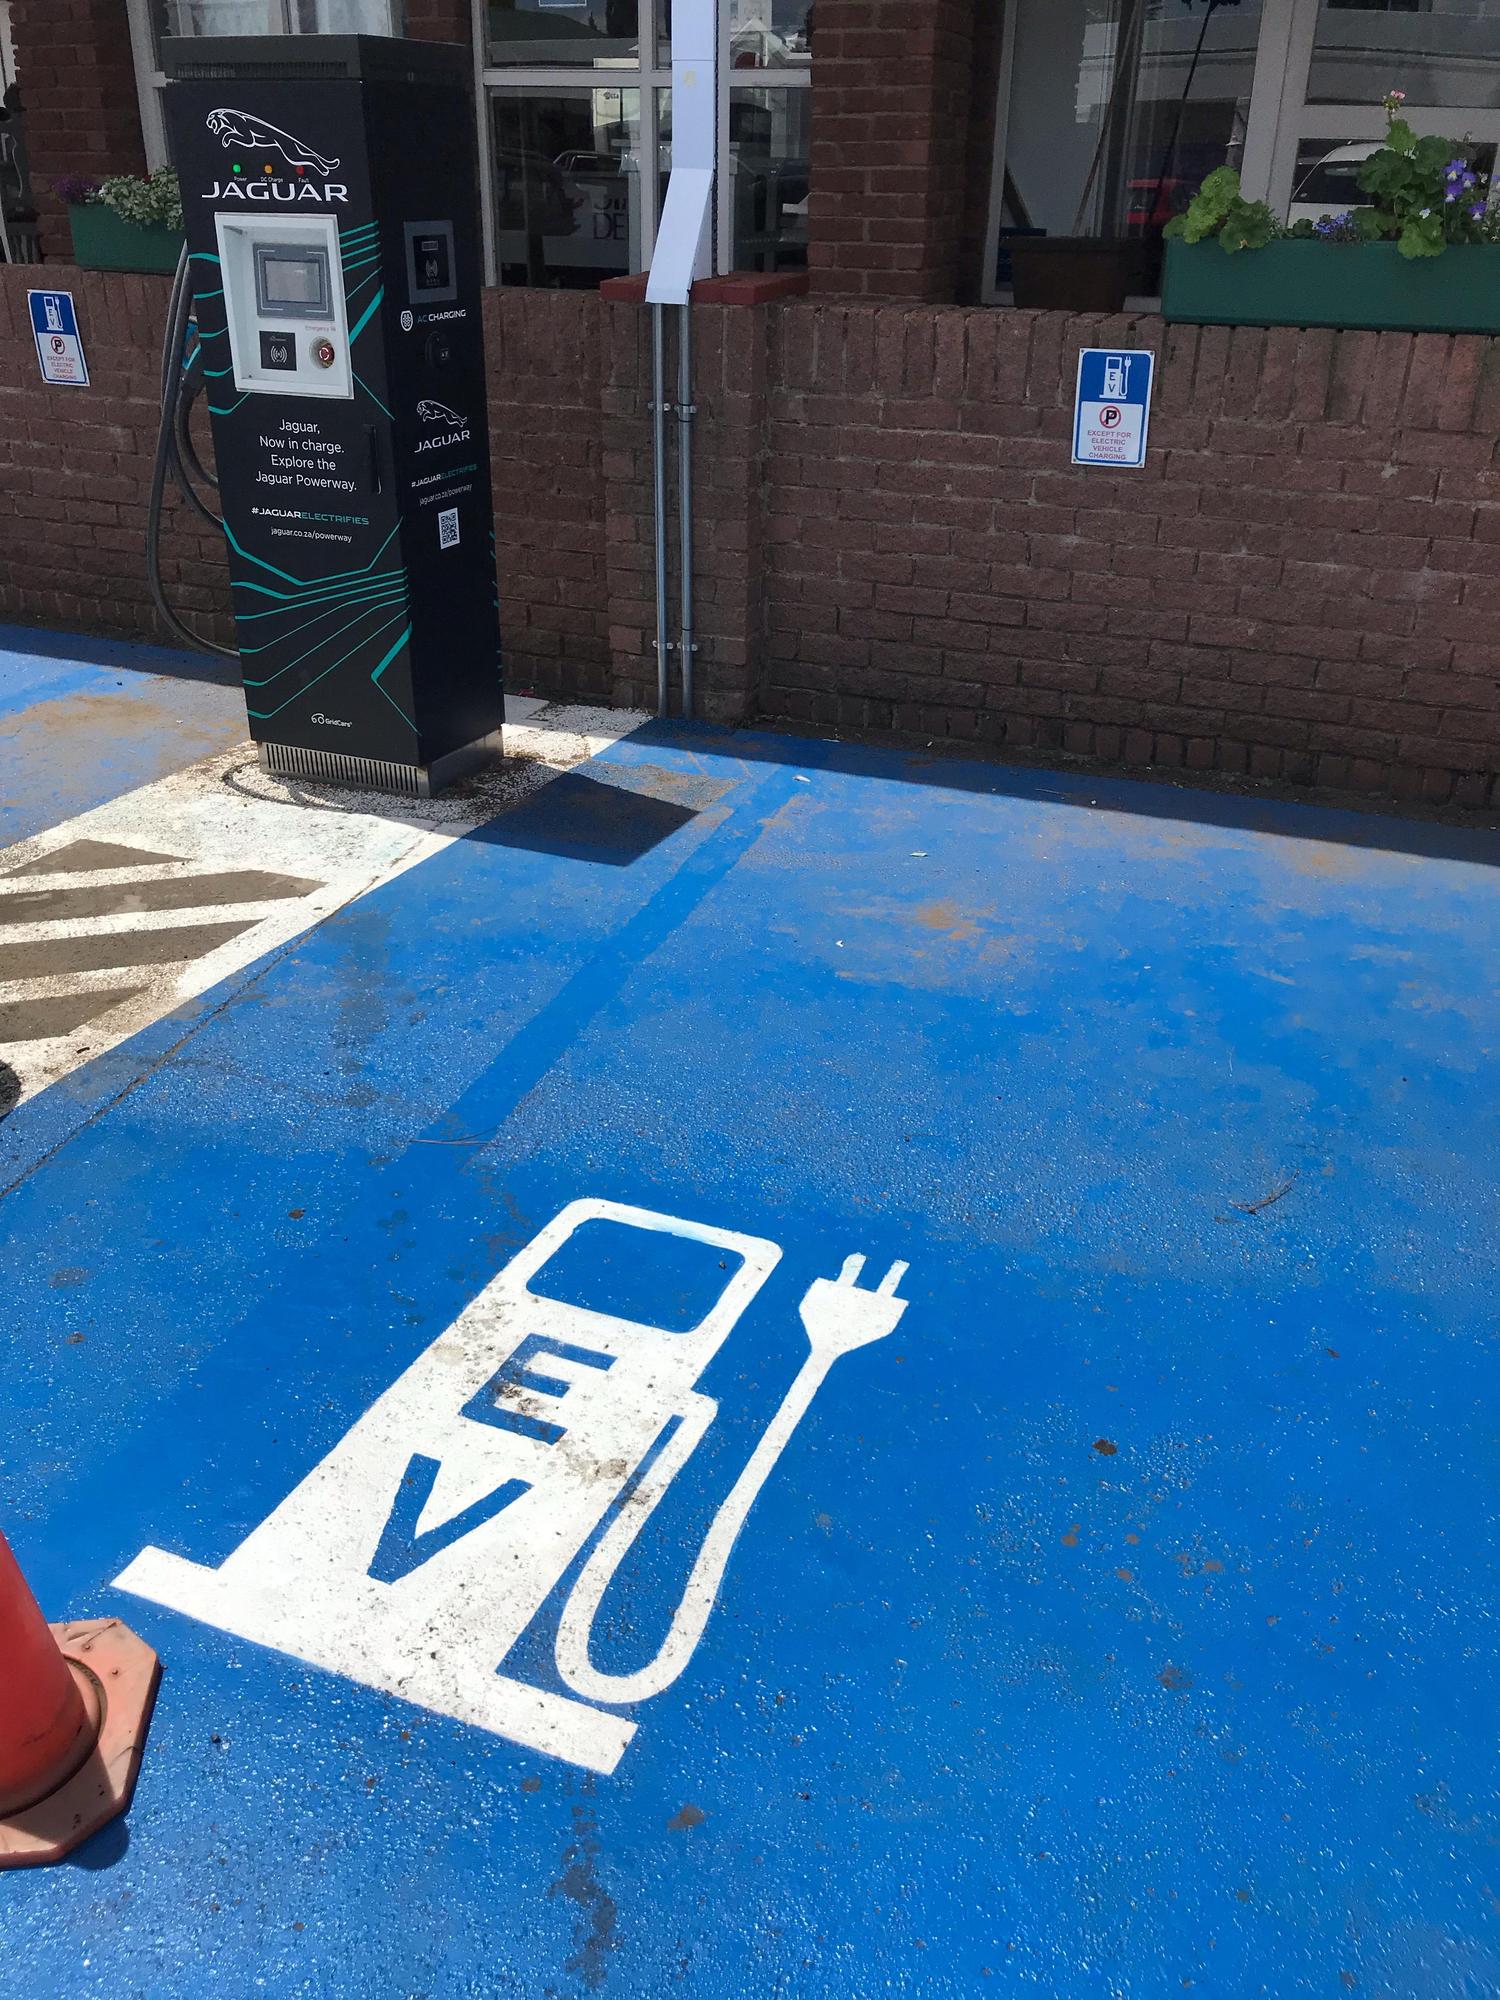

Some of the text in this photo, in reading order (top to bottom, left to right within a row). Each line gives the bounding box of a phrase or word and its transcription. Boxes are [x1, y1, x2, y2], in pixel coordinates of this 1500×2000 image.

[201, 181, 349, 202] JAGUAR
[428, 309, 467, 322] CHARGING
[1105, 409, 1118, 424] P
[279, 419, 320, 434] Jaguar,
[260, 435, 345, 455] Now in charge.
[414, 429, 471, 453] JAGUAR
[271, 454, 337, 471] Explore the
[256, 471, 357, 492] Jaguar Powerway.
[251, 506, 370, 525] #JAGUARELECTRIFIES
[271, 527, 353, 543] jaguar.co.za/powerway
